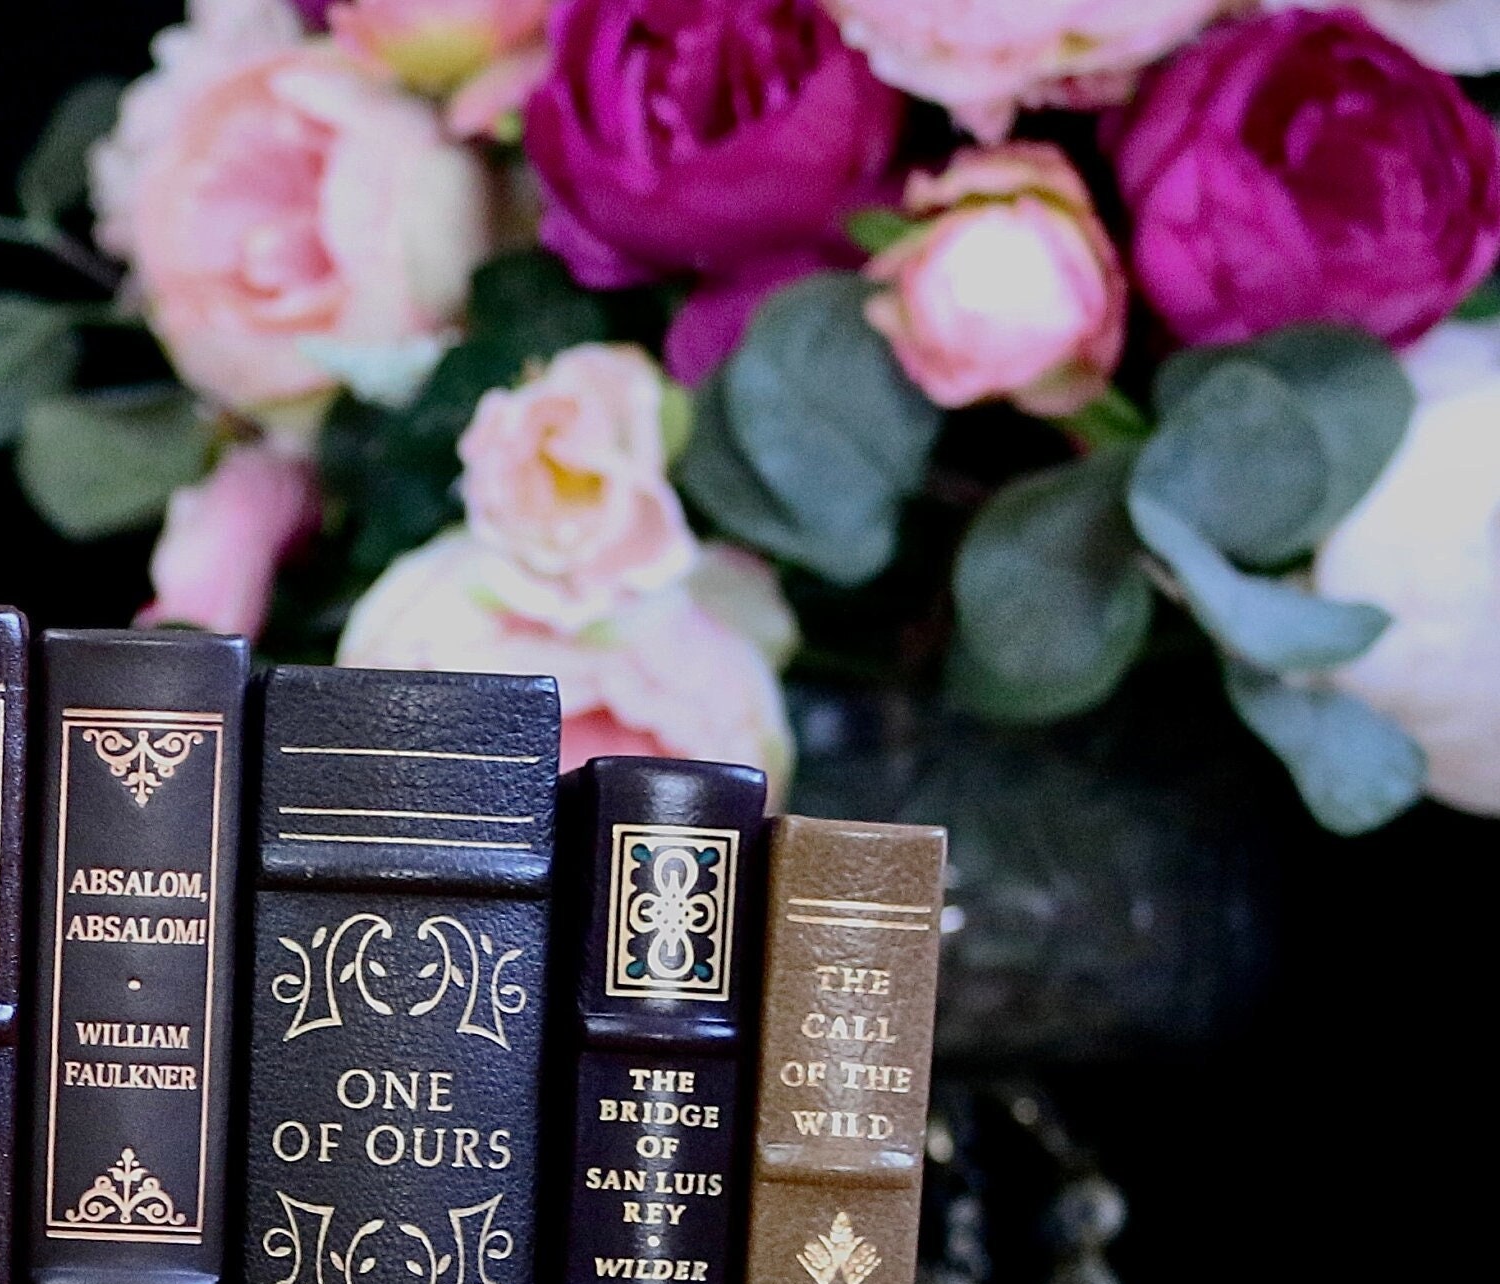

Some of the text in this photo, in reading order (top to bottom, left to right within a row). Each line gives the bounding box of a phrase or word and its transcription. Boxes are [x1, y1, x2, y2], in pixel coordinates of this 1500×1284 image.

[69, 868, 208, 902] ABSALOM,
[66, 916, 206, 945] ABSALOM!
[816, 965, 890, 996] THE
[75, 1022, 190, 1049] WILLIAM
[801, 1013, 897, 1045] CALL
[64, 1061, 197, 1090] FAULKNER
[337, 1068, 453, 1112] ONE
[629, 1069, 695, 1093] THE
[780, 1062, 912, 1094] OF THE
[599, 1100, 719, 1128] BRIDGE
[792, 1110, 894, 1140] WILD
[272, 1121, 512, 1169] OF OURS
[636, 1136, 680, 1159] OF
[585, 1168, 722, 1196] SAN LUIS
[622, 1201, 686, 1226] REY
[594, 1257, 708, 1281] WILDER
